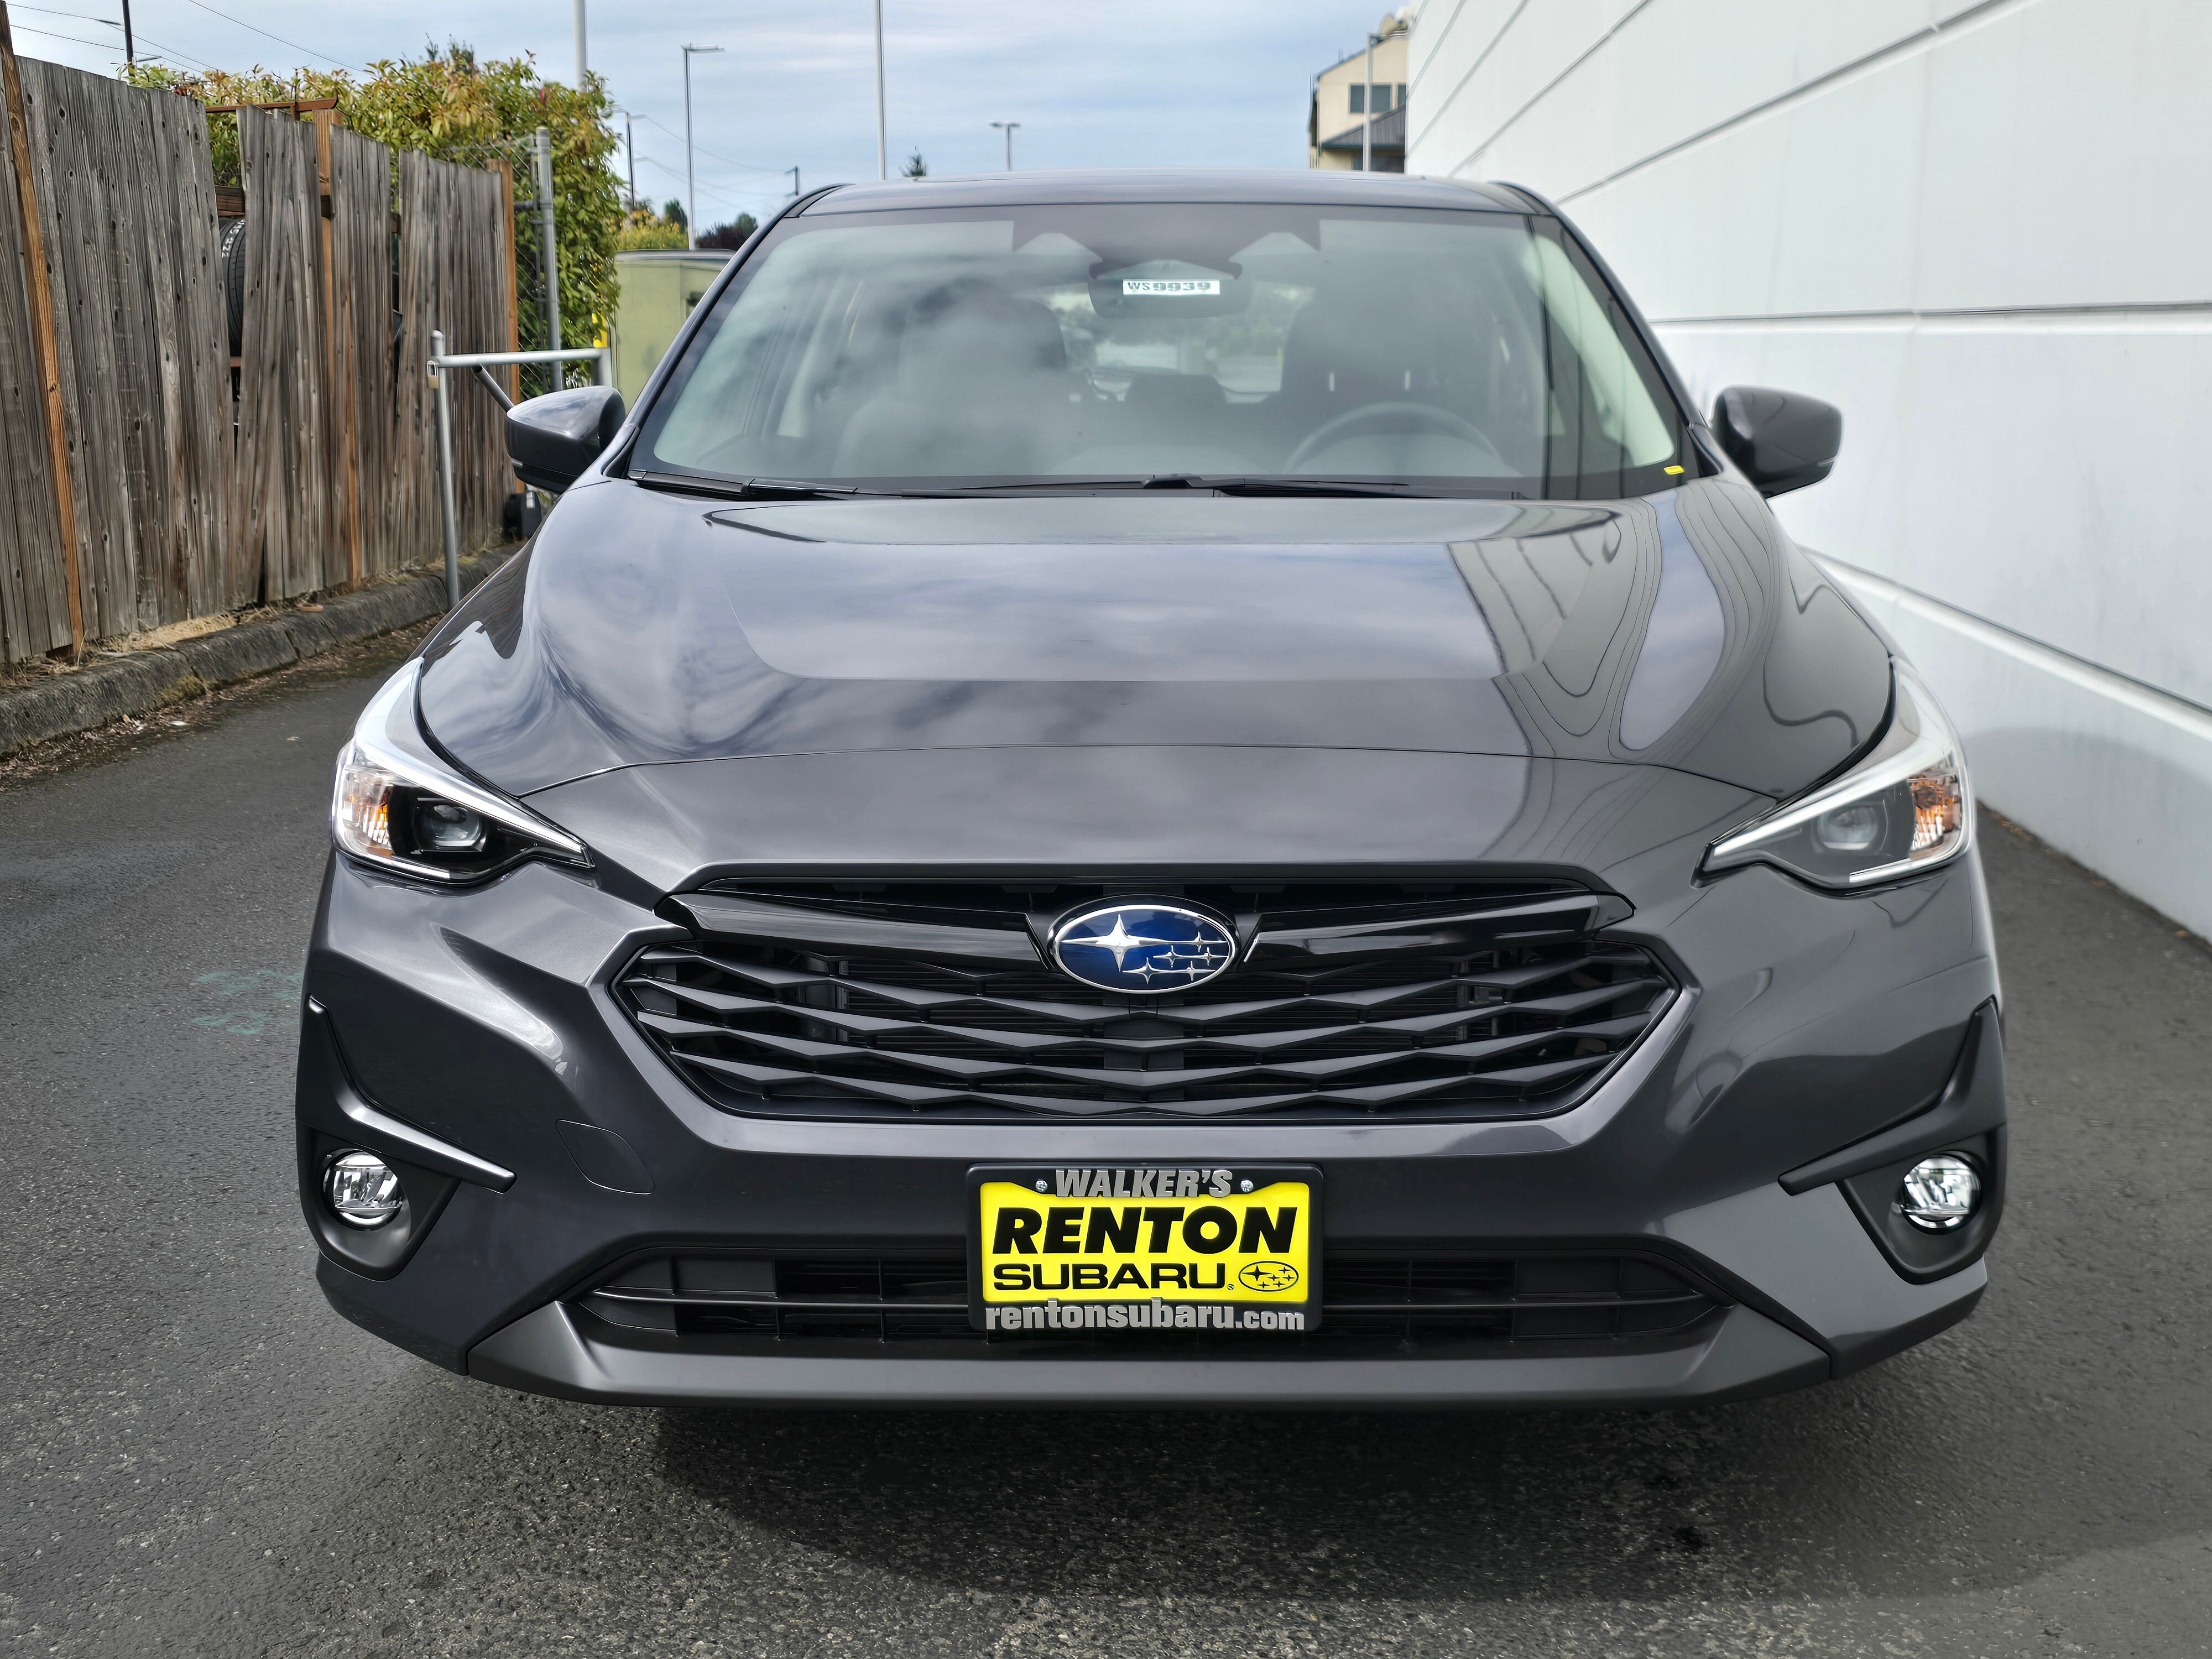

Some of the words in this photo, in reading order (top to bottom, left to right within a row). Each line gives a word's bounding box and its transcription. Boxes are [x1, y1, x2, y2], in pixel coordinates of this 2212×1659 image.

[1056, 1169, 1232, 1197] WALKER'S
[992, 1206, 1297, 1254] RENTON
[993, 1263, 1224, 1290] SUBARU
[985, 1297, 1304, 1330] rentonsubaru.com
